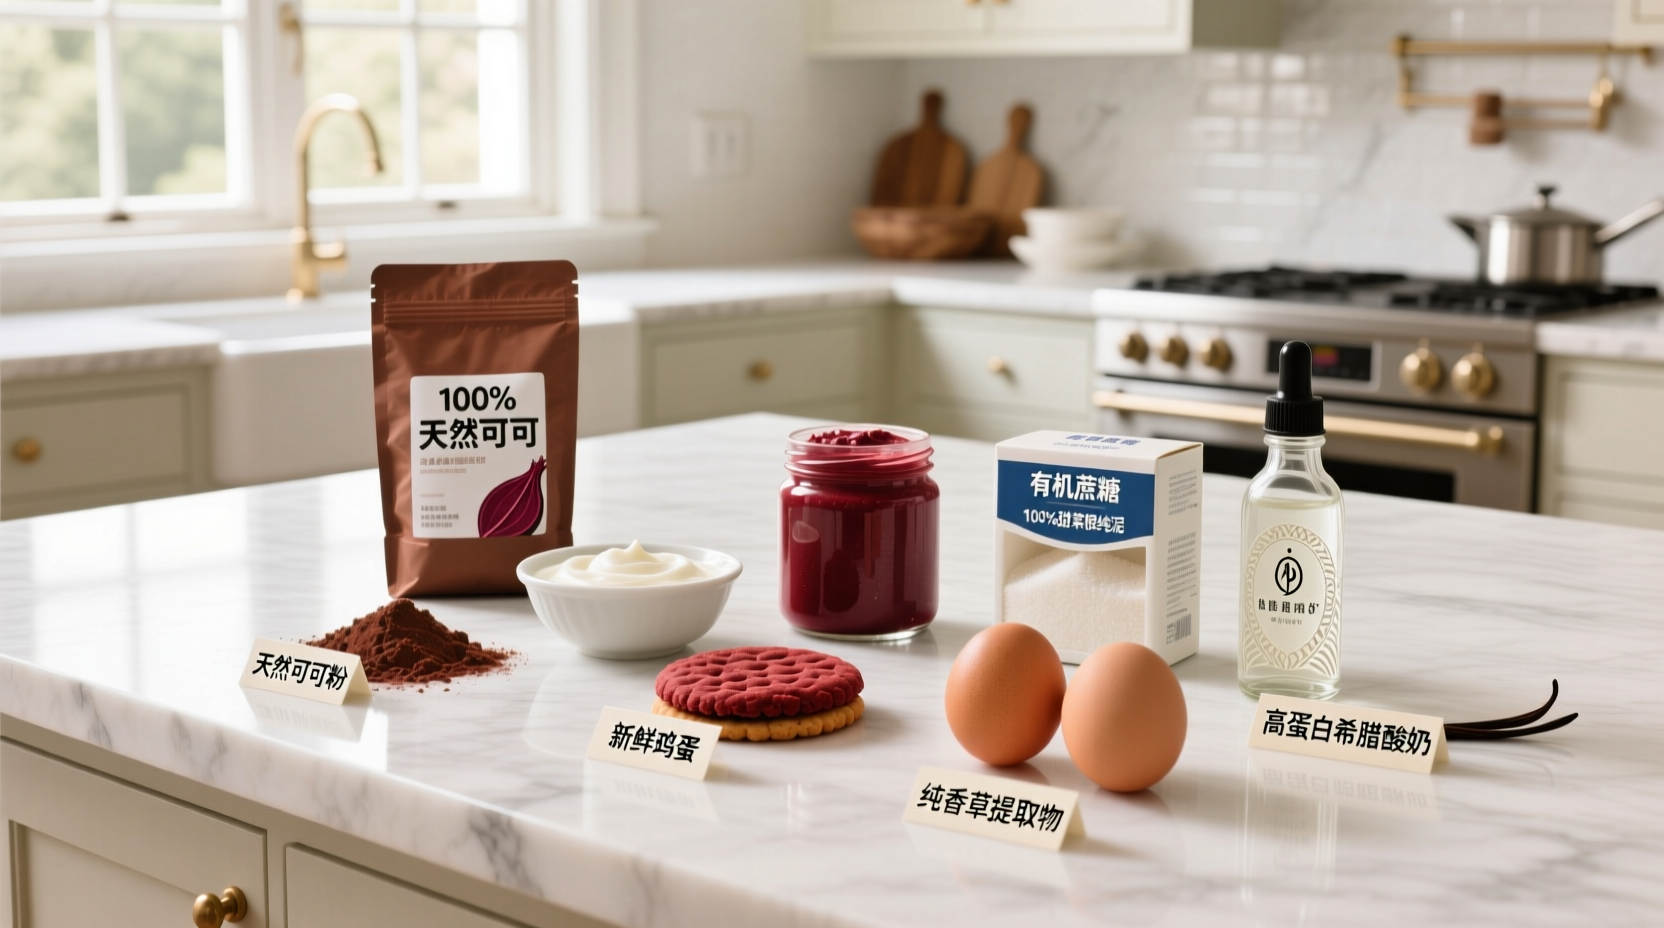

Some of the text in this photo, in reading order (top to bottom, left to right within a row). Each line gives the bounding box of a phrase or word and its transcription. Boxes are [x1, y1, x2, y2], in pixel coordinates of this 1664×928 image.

[439, 386, 517, 412] 100%
[419, 417, 539, 450] 天然可可
[1030, 470, 1121, 504] 有机蔗糖
[252, 652, 348, 690] 天然可可粉
[608, 721, 701, 763] 新鲜鸡蛋
[1263, 708, 1432, 757] 高蛋白希腊酸奶
[917, 782, 1065, 832] 纯香草提取物
